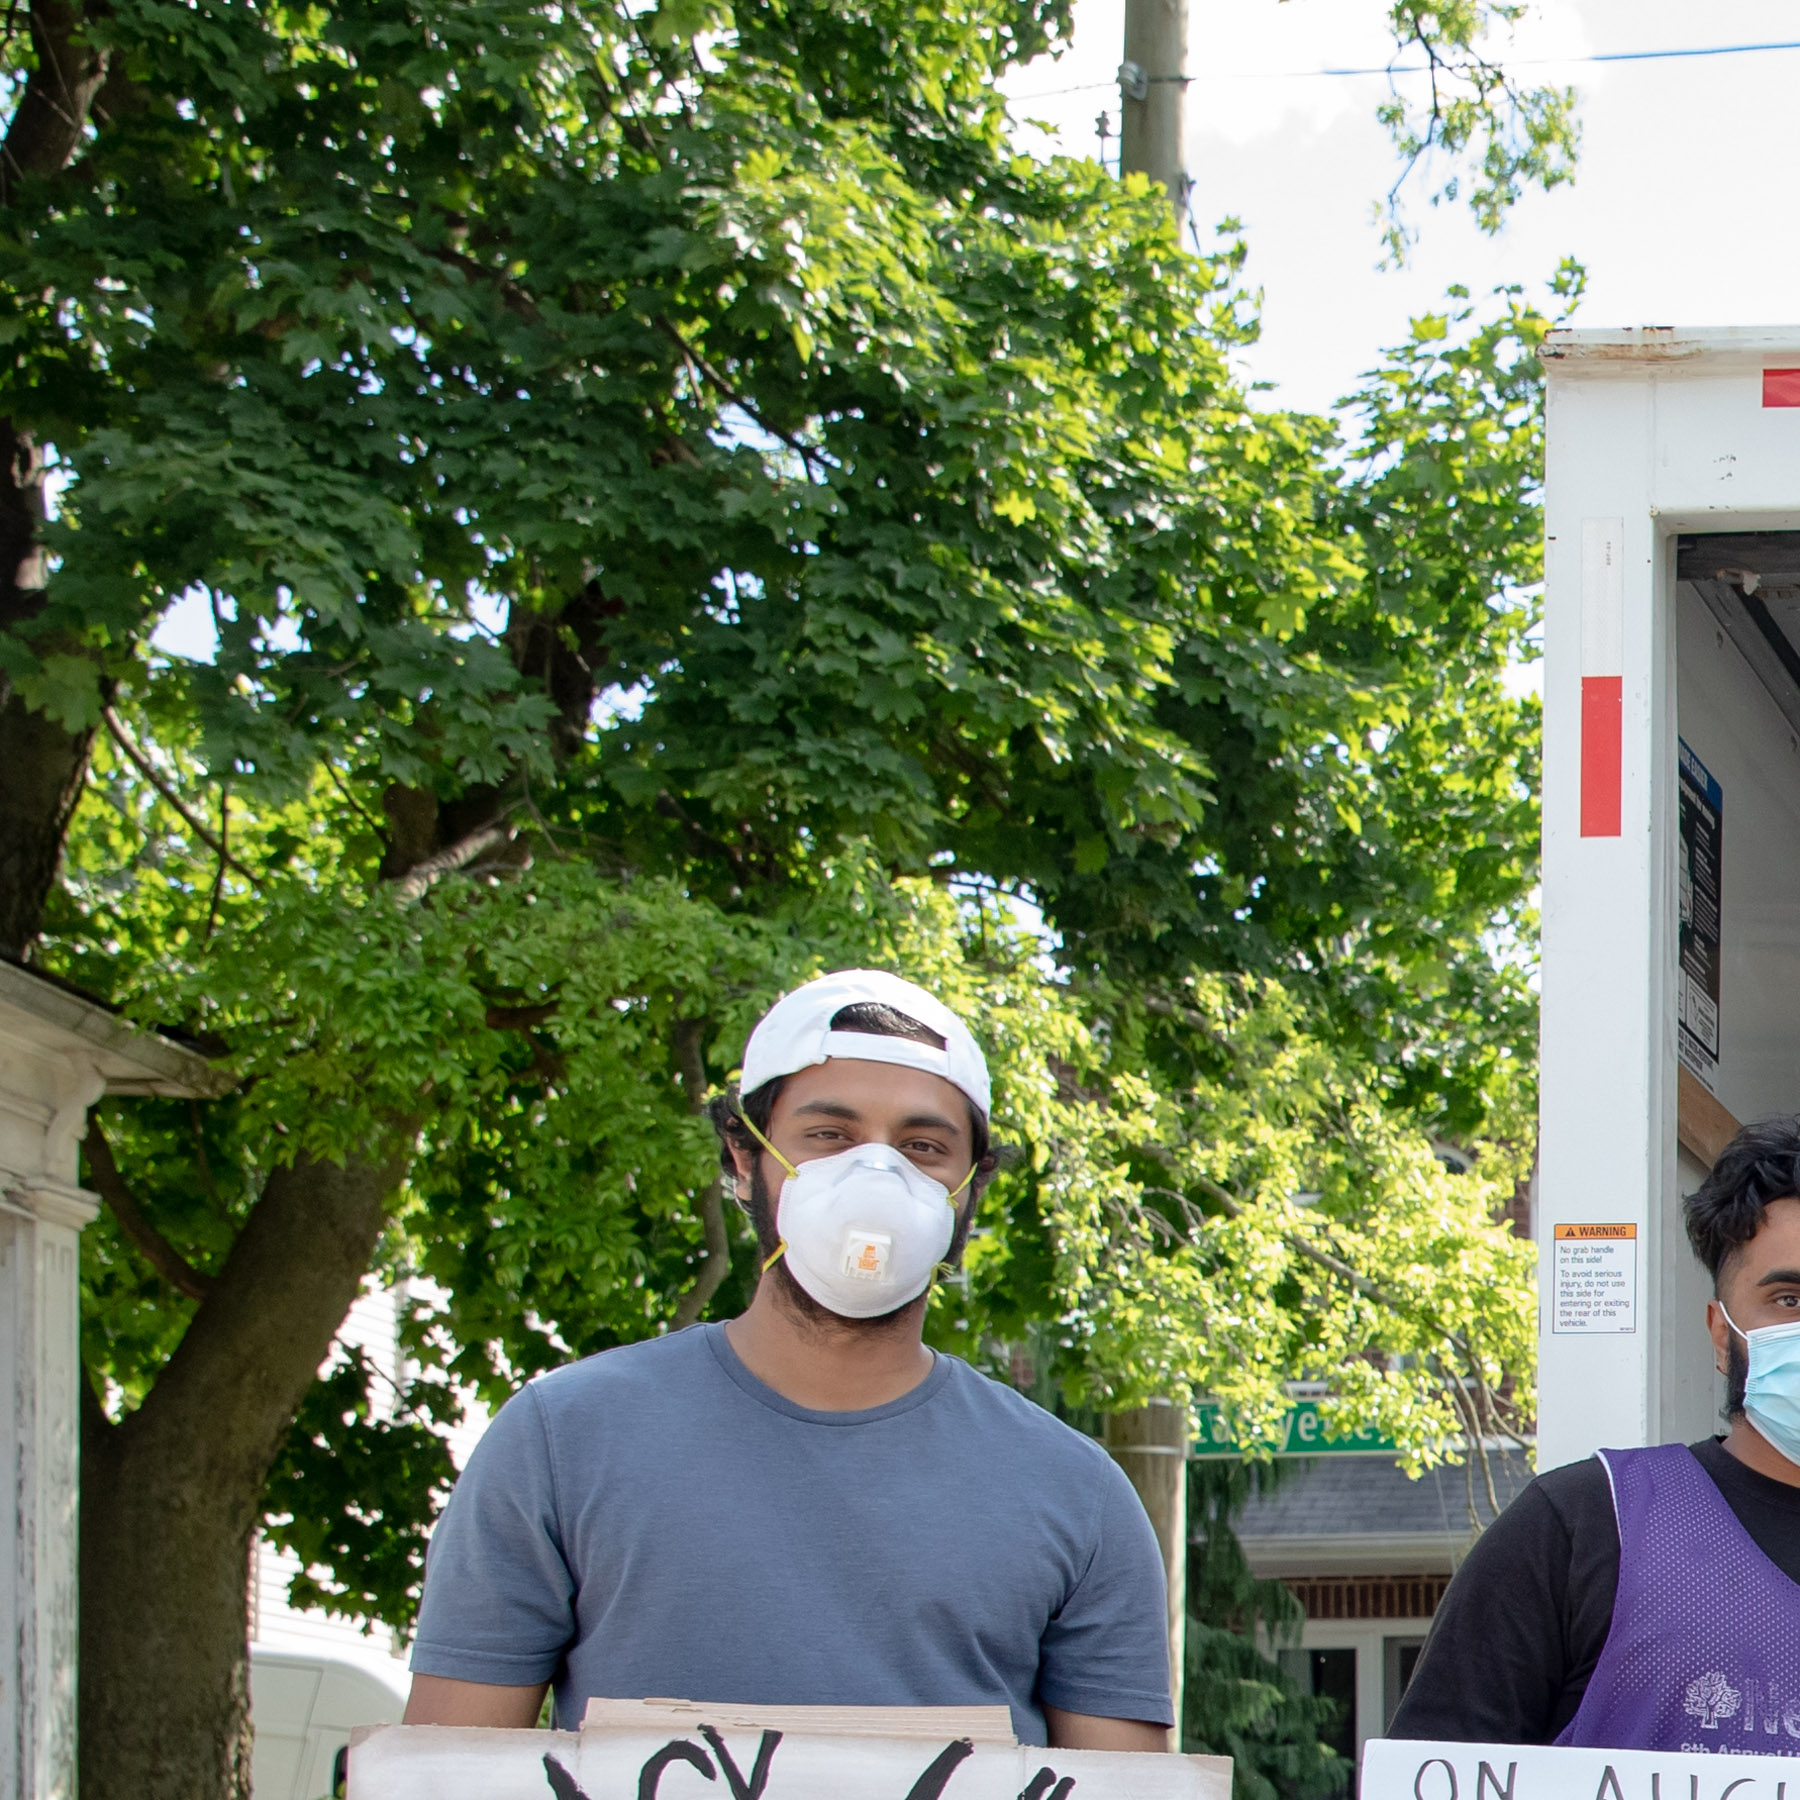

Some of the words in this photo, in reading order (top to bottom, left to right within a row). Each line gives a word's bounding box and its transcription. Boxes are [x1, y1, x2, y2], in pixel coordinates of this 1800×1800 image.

[1579, 1227, 1626, 1236] WARNING
[1573, 1246, 1589, 1255] grab
[1561, 1300, 1591, 1308] entering
[1604, 1300, 1629, 1308] exiting
[1560, 1319, 1587, 1327] vehicle.
